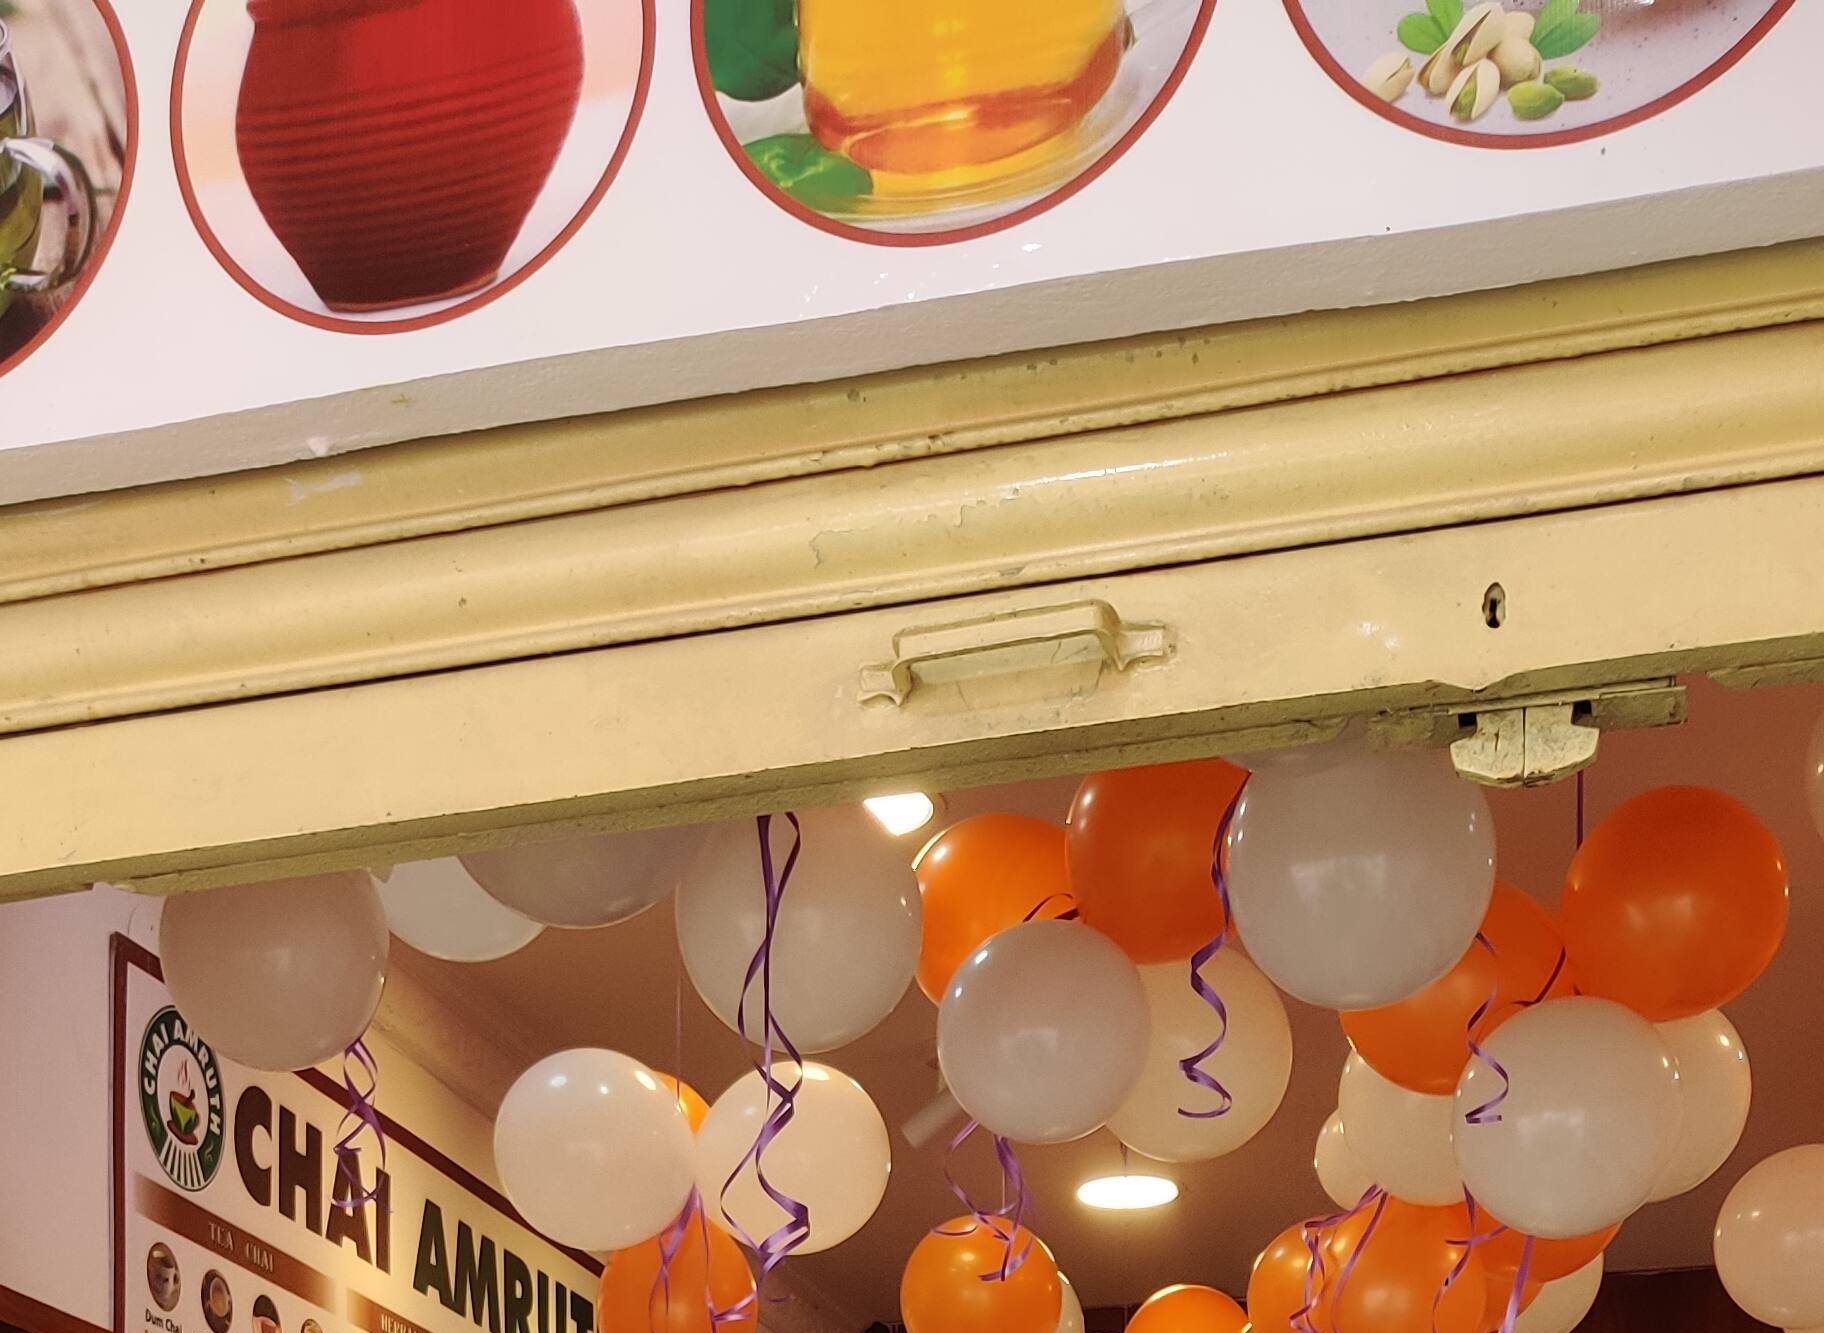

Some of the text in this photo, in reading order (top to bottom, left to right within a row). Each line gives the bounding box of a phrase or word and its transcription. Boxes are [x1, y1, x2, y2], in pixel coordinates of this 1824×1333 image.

[143, 1019, 221, 1136] CHAI AMRUTH
[234, 1085, 392, 1275] CHAI
[207, 1223, 274, 1273] TEA CHAI
[145, 1309, 164, 1328] Dum
